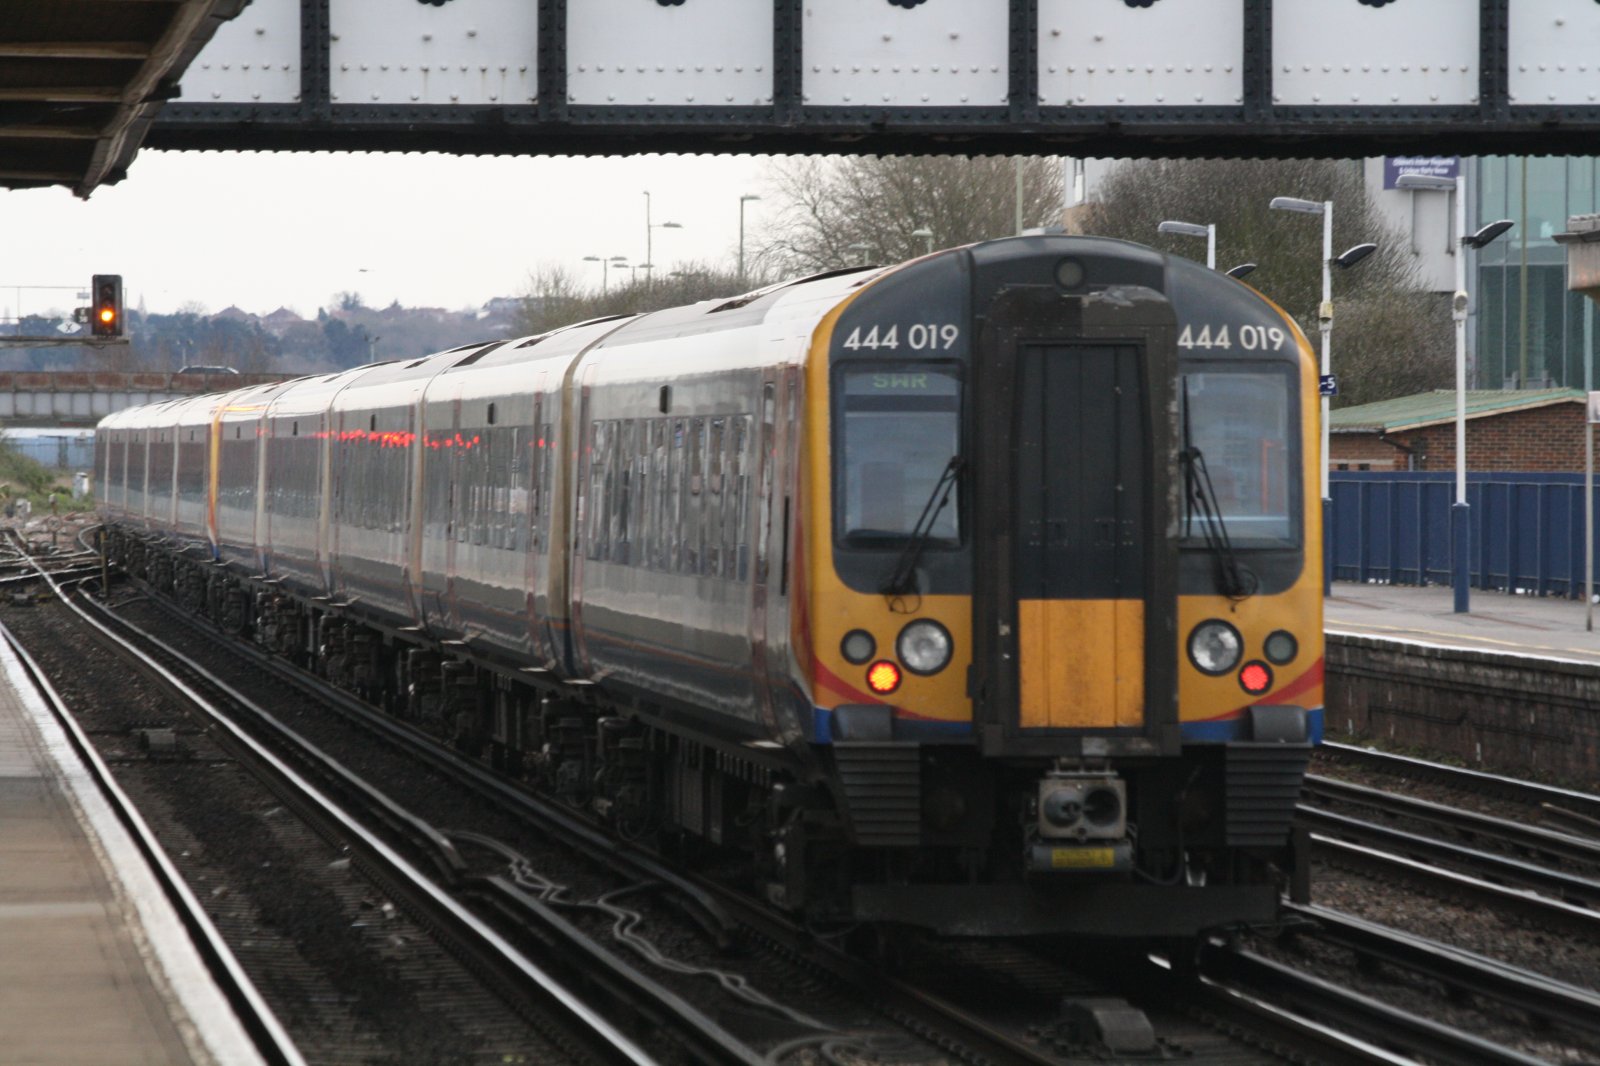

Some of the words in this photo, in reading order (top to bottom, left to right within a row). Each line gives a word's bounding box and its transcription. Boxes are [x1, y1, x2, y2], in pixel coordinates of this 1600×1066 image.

[843, 324, 899, 351] 444
[908, 324, 958, 350] 019
[1177, 323, 1232, 350] 444
[1239, 324, 1284, 351] 019
[872, 373, 928, 388] SWR
